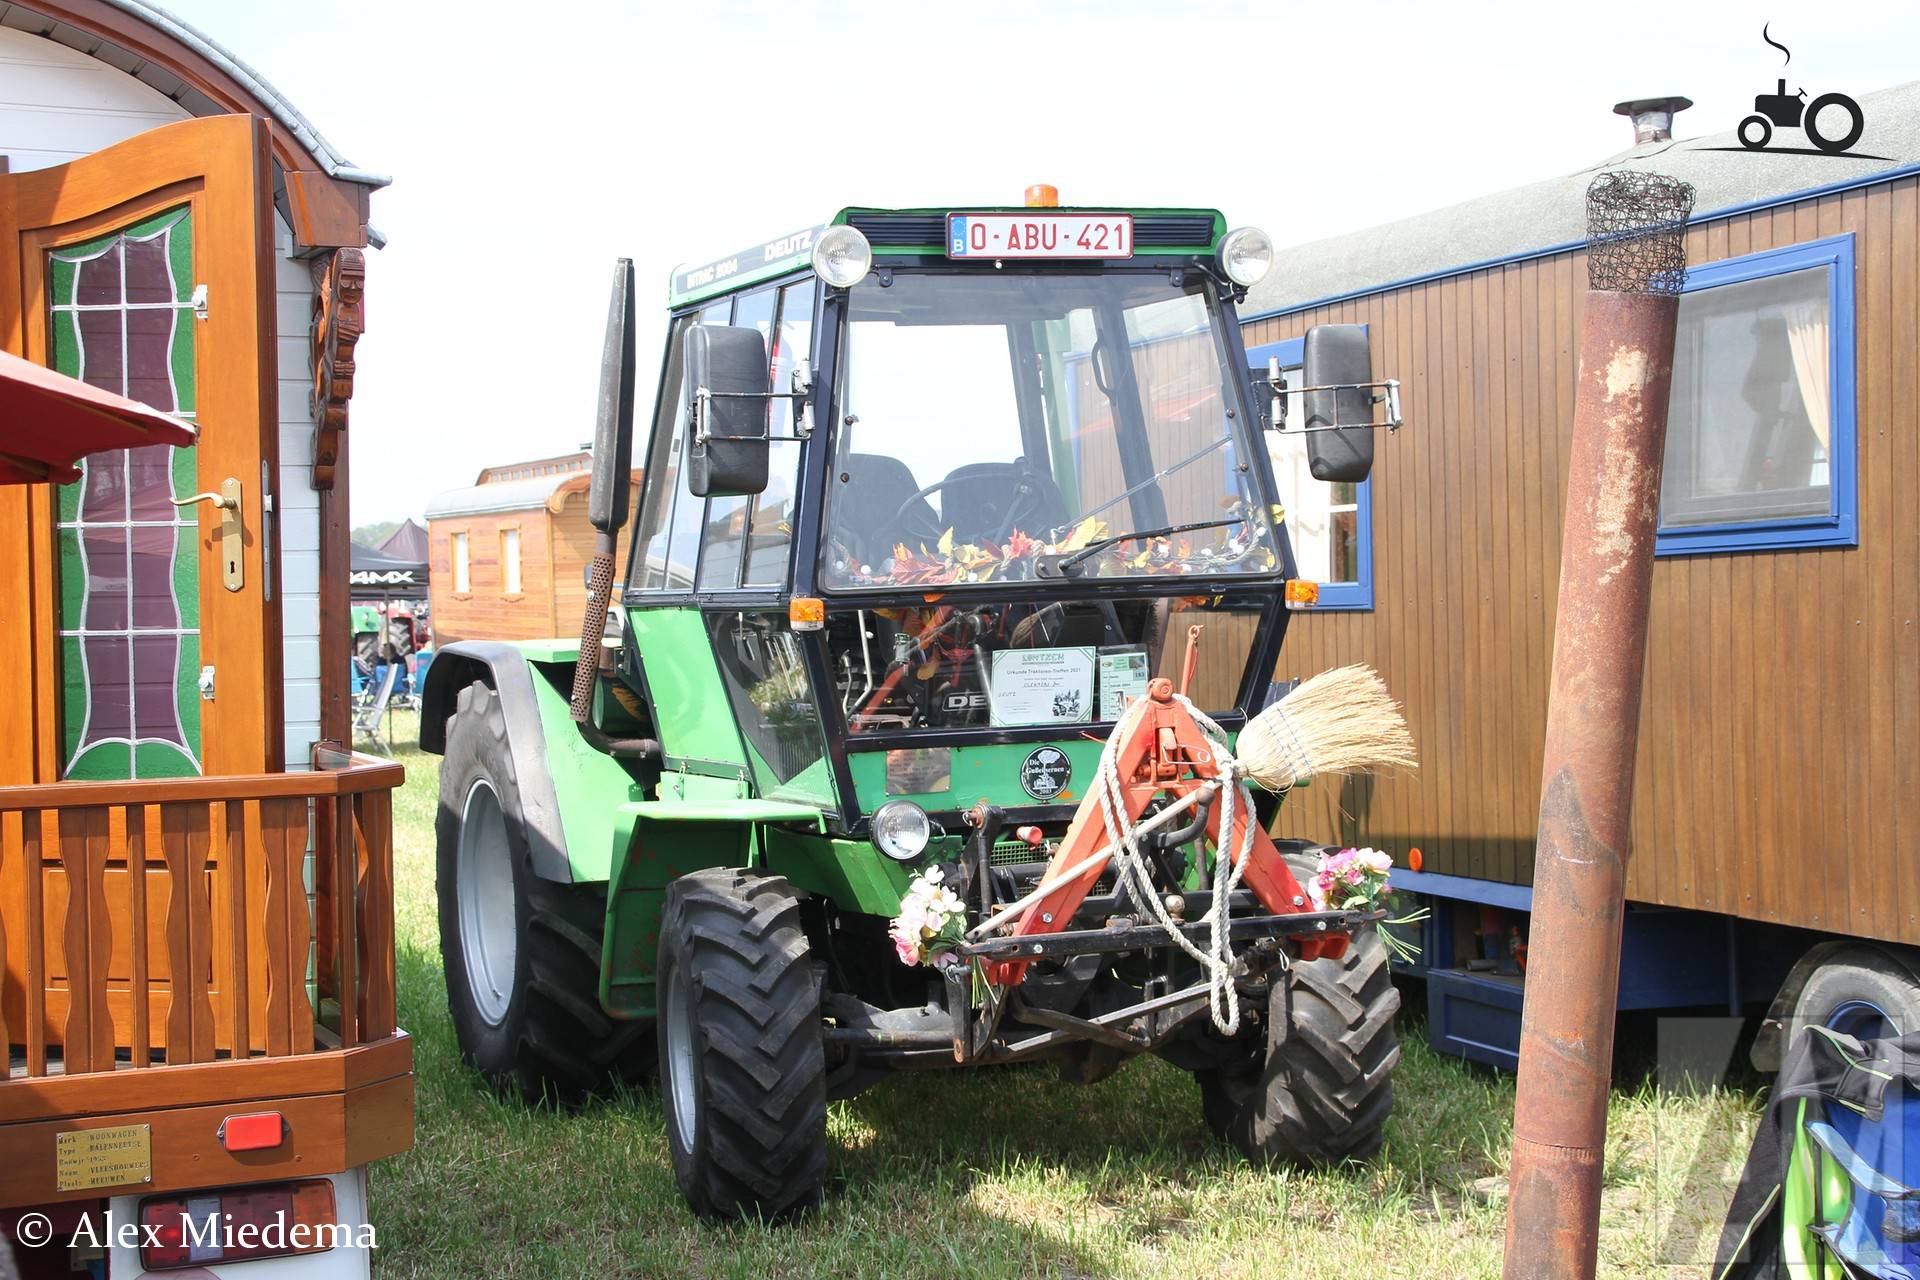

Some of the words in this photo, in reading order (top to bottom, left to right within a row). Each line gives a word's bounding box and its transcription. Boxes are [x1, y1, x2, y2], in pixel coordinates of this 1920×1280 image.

[764, 230, 813, 261] DEUTZ
[953, 239, 964, 252] B
[350, 571, 415, 584] AMX
[948, 695, 986, 708] DE
